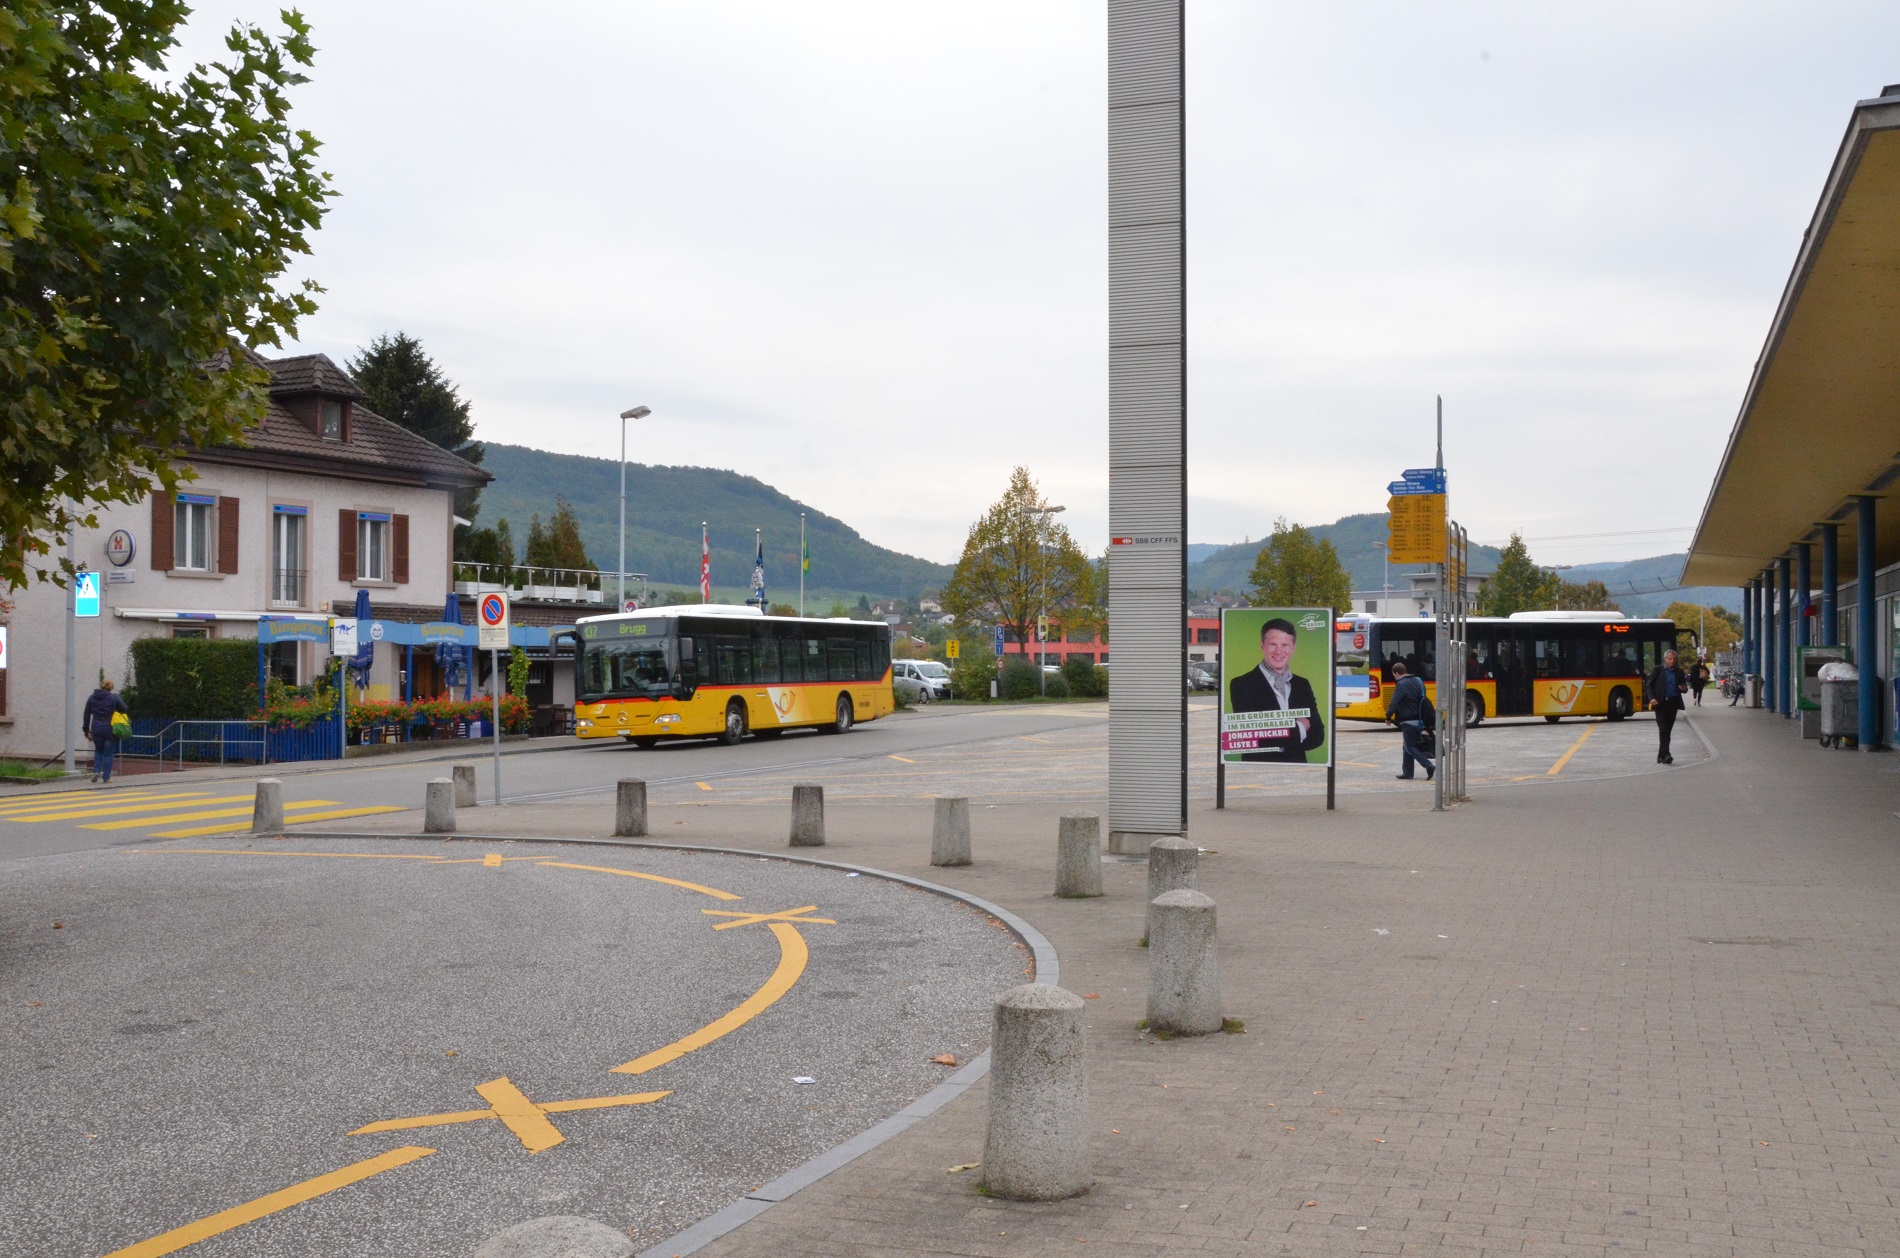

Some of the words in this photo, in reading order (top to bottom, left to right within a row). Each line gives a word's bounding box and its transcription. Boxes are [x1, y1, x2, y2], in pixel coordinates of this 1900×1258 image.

[269, 621, 323, 635] Biergarten
[620, 624, 646, 634] Brugg
[1227, 713, 1246, 721] IHRE
[1247, 711, 1275, 719] GRÜNE
[1276, 709, 1309, 718] STIMME
[1240, 720, 1293, 729] NATIONALRAT
[1228, 731, 1253, 741] JONAS
[1254, 730, 1288, 738] FRICKER
[1229, 741, 1251, 749] LISTE
[1252, 740, 1258, 748] 5
